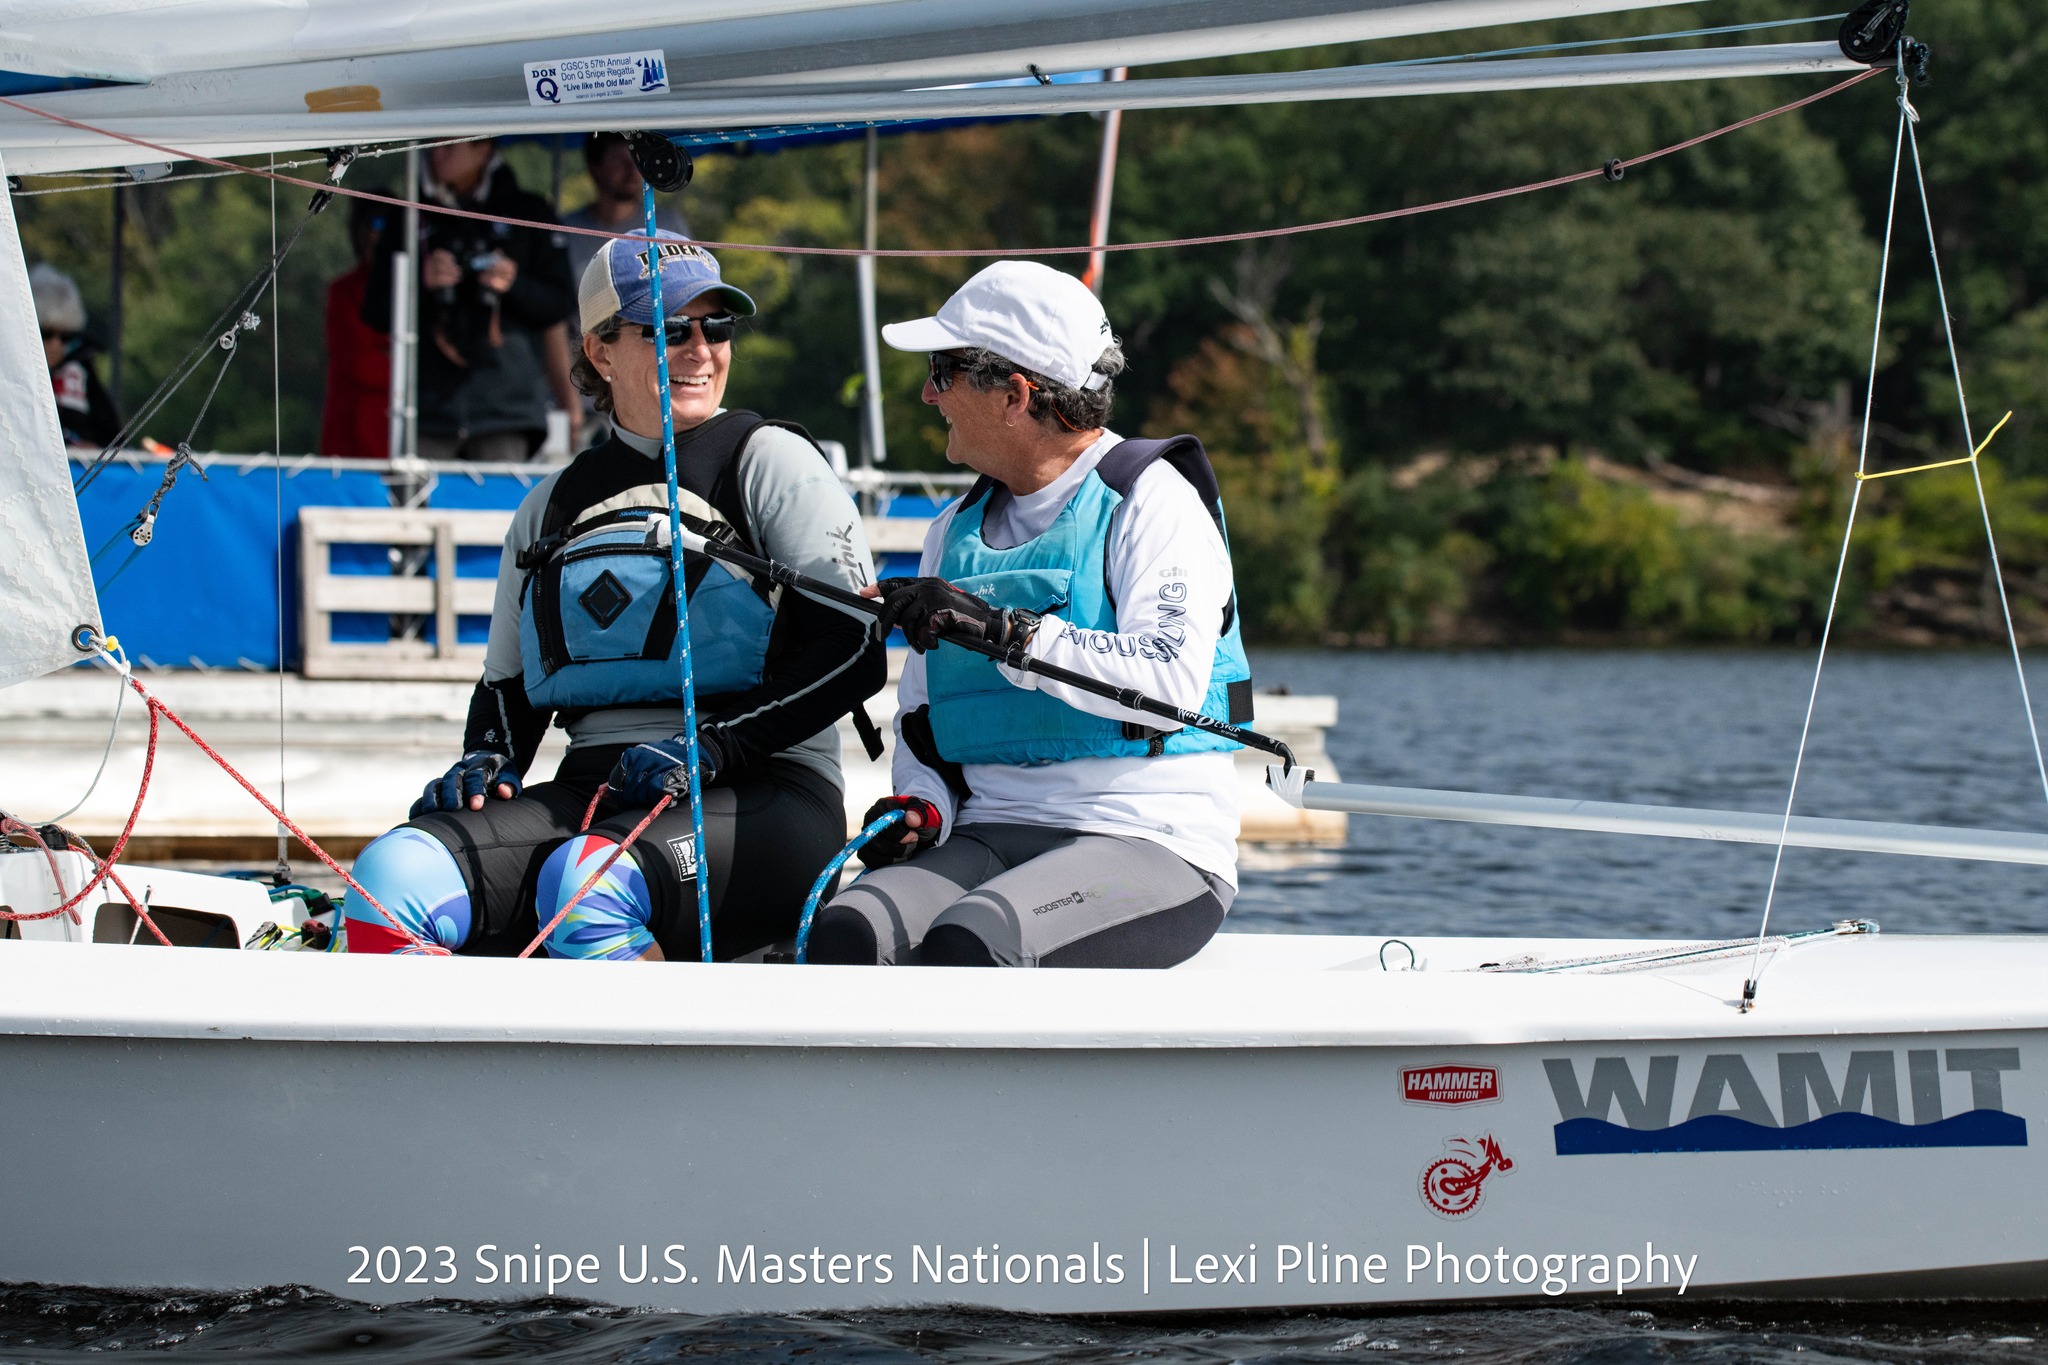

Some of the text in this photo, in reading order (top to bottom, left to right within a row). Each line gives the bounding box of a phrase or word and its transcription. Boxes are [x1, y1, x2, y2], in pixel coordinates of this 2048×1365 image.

[561, 56, 632, 72] CGSC's 57th Annual
[532, 68, 556, 78] DON
[561, 66, 635, 81] Don Q Snipe Regatta
[535, 77, 561, 103] Q
[582, 82, 593, 90] like
[606, 79, 618, 87] Old
[636, 242, 701, 266] TLDEN
[1159, 566, 1189, 579] Gill
[1032, 896, 1075, 916] ROOSTER
[1407, 1071, 1493, 1091] HAMMER
[1428, 1090, 1479, 1100] NUTRITION
[1541, 1047, 2021, 1132] WAMIT
